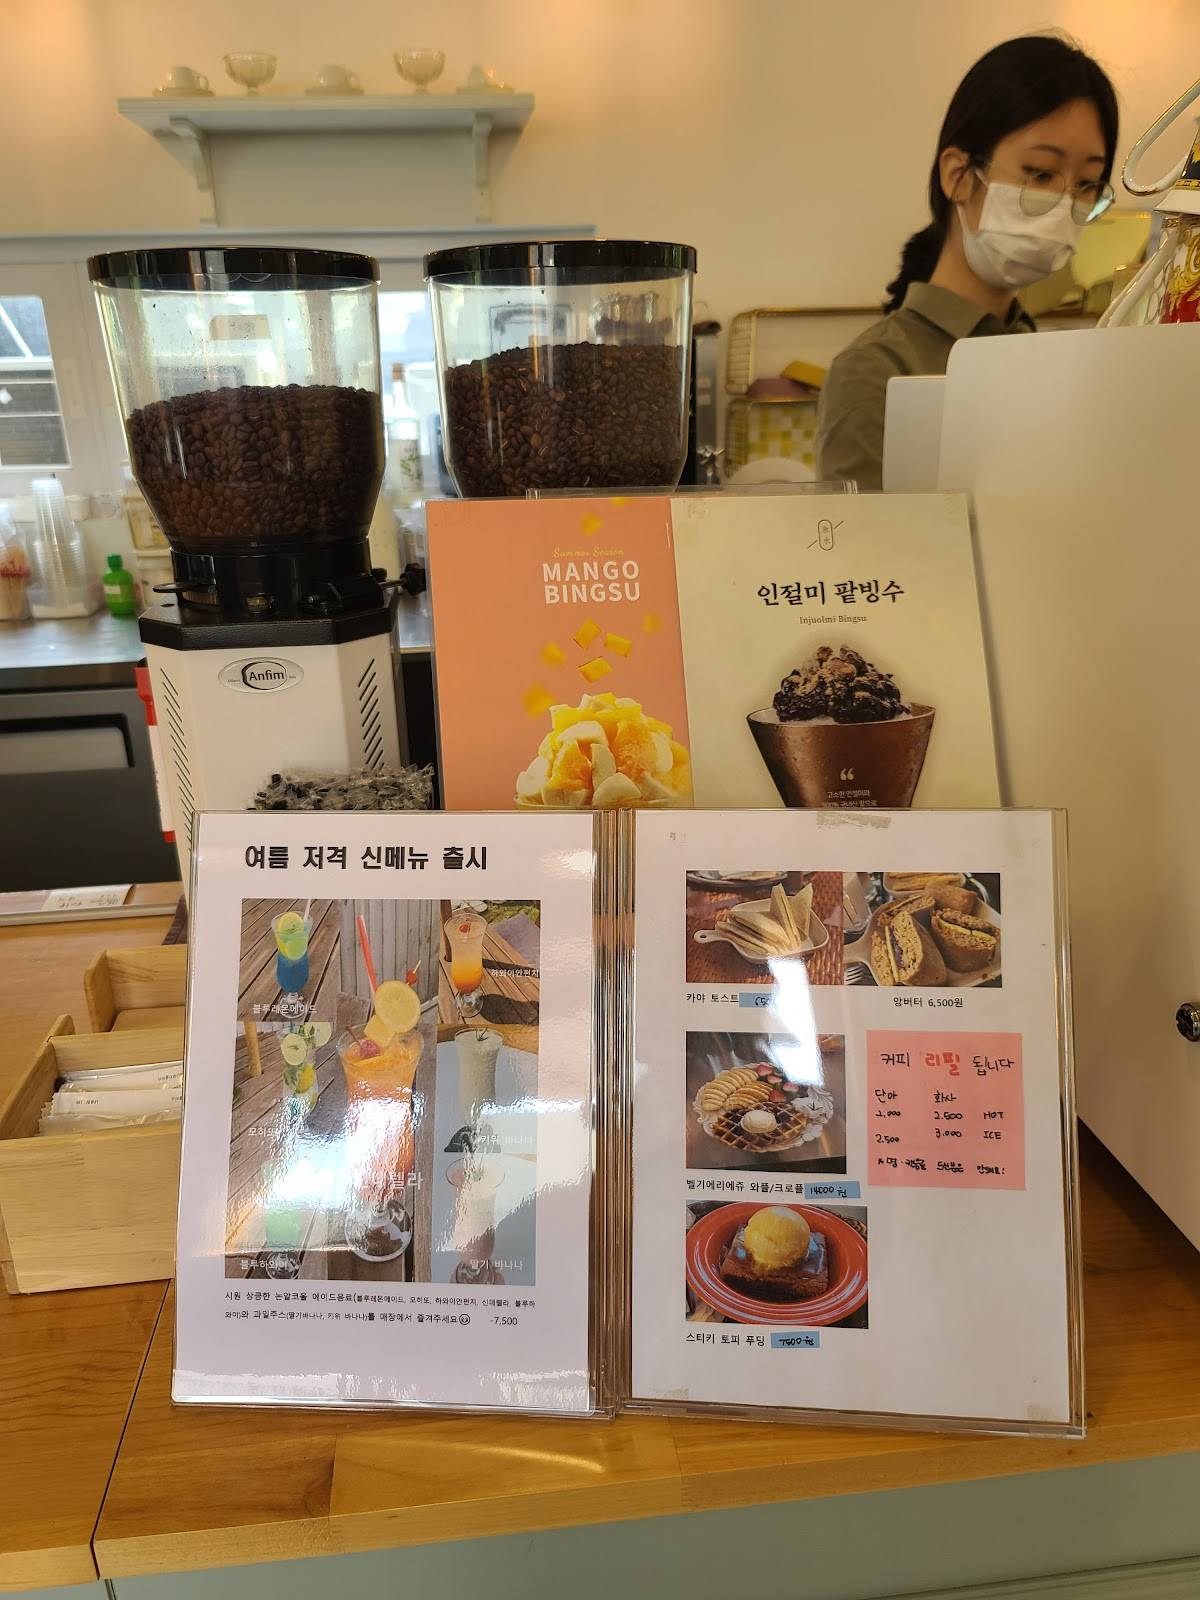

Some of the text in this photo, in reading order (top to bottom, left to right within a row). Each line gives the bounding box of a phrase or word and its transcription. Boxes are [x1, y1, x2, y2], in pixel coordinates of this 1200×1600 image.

[542, 560, 640, 582] MANGO
[544, 582, 640, 604] BINGSU
[757, 579, 905, 606] 인절미 팥빙수
[800, 615, 867, 626] Injuolmi Bingsu
[249, 669, 285, 681] Anfim
[245, 845, 487, 870] 여름 저격 신메뉴 출시
[686, 992, 705, 1003] 카야
[711, 993, 739, 1003] 토스트
[893, 997, 963, 1008] 앙버터 6,500원
[253, 1003, 318, 1015] 블루레몬에이드
[880, 1052, 1015, 1077] 커피 리필 됩니다
[983, 1111, 1004, 1120] HOT
[983, 1130, 1002, 1140] ICE
[750, 1182, 804, 1194] 와플/크로플
[471, 1259, 523, 1271] 딸기 바나나
[225, 1291, 241, 1300] 시원
[379, 1313, 412, 1322] 매장에서
[490, 1316, 518, 1326] -7,500
[686, 1333, 715, 1344] 스티키
[721, 1334, 740, 1345] 토피
[745, 1335, 765, 1347] 푸딩
